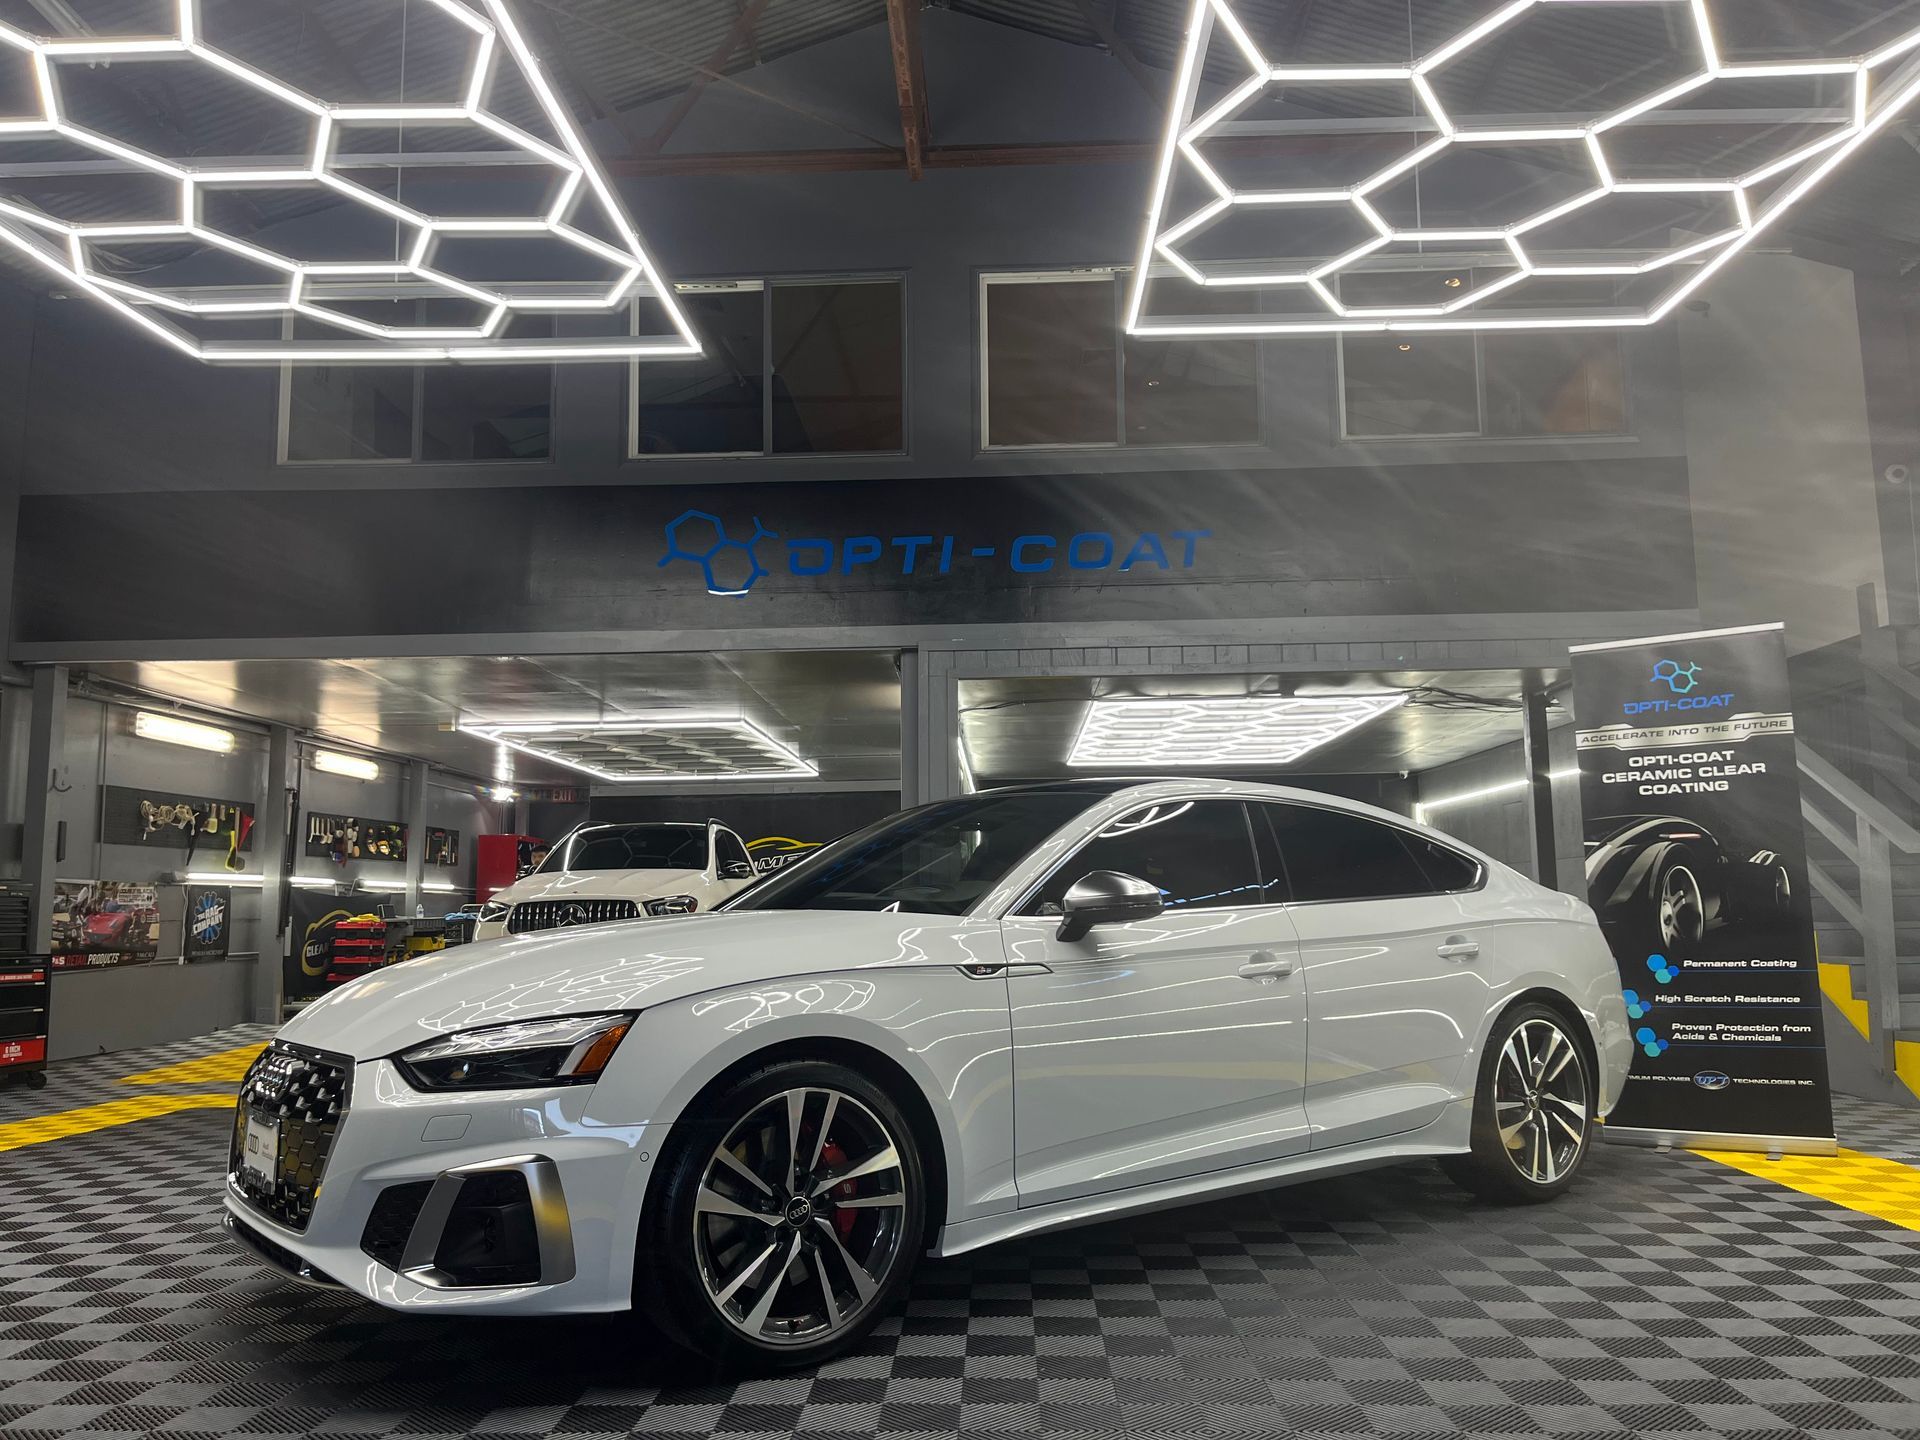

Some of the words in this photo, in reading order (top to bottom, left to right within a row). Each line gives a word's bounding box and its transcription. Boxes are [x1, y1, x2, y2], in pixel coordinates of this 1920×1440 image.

[785, 529, 1213, 577] OPTI-COAT
[1623, 693, 1735, 715] OPTI-COAT
[1580, 730, 1664, 744] ACCELERATE
[1668, 727, 1699, 737] INTO
[1704, 724, 1729, 734] THE
[1733, 719, 1788, 731] FUTURE
[1628, 750, 1735, 768] OPTI-COAT
[1601, 768, 1692, 784] CERAMIC
[1698, 762, 1766, 778] CLEAR
[552, 788, 575, 802] EXIT
[1638, 780, 1729, 796] COATING
[87, 952, 120, 966] PRODUCTS
[1683, 959, 1747, 968] Permanent
[1750, 959, 1797, 969] Coating
[1655, 994, 1681, 1004] High
[1684, 994, 1732, 1003] Scratch
[1734, 995, 1801, 1003] Resistance
[1671, 1022, 1713, 1032] Proven
[1715, 1023, 1779, 1032] Protection
[1782, 1024, 1812, 1033] from
[1672, 1032, 1705, 1041] Acids
[1708, 1033, 1718, 1041] &
[1721, 1033, 1782, 1042] Chemicals
